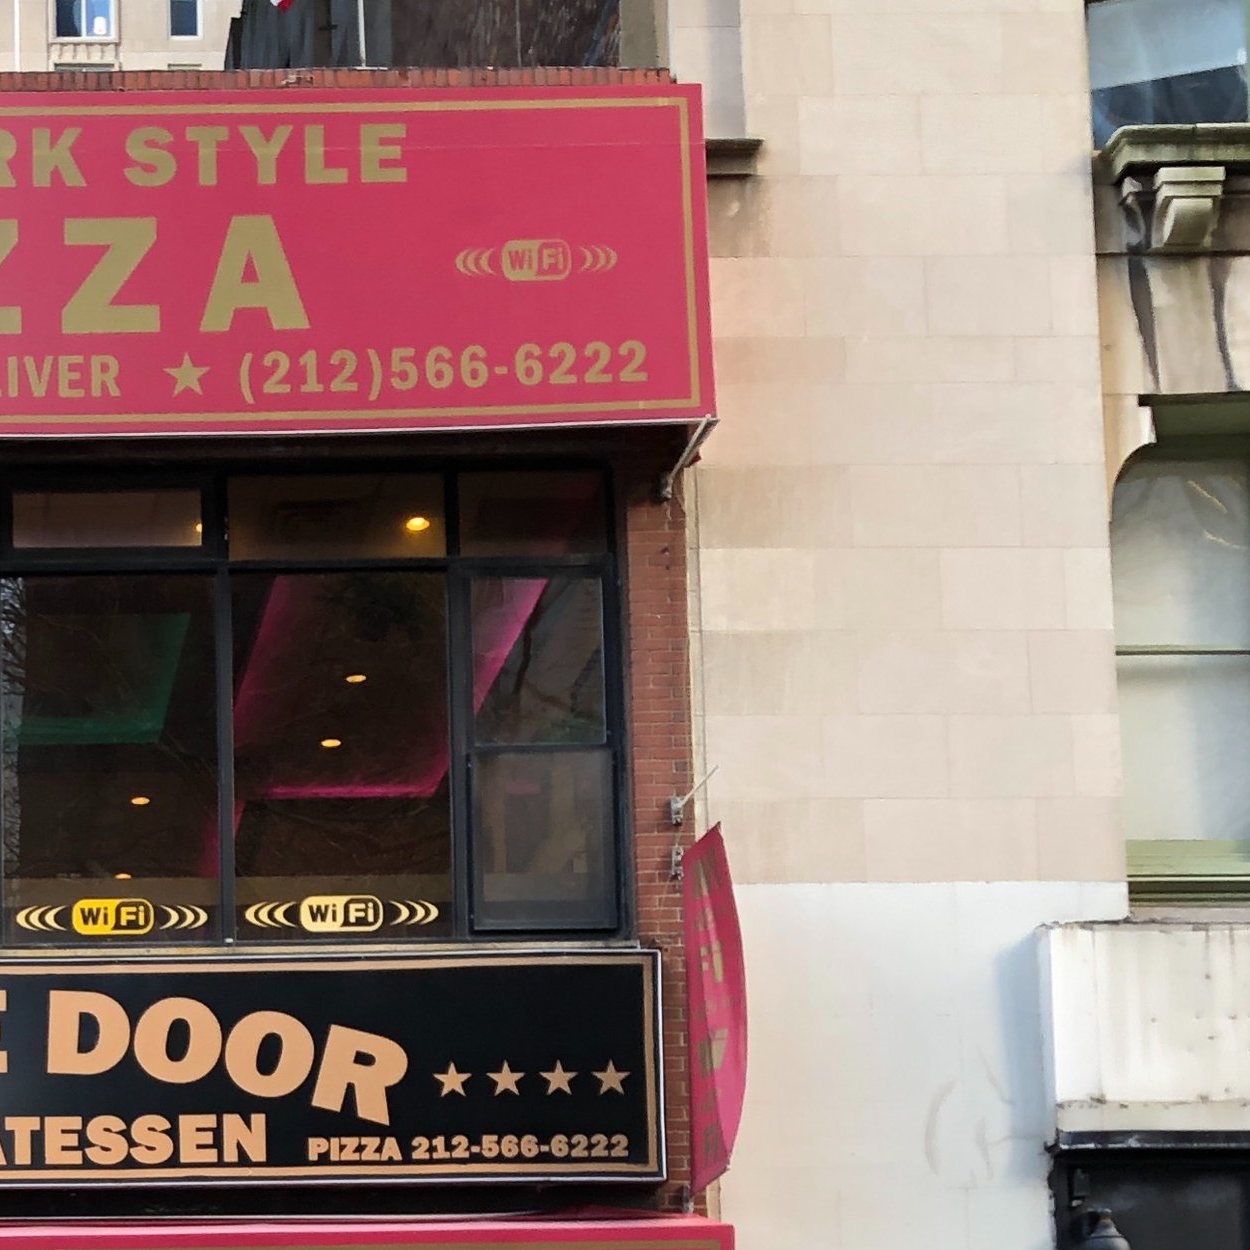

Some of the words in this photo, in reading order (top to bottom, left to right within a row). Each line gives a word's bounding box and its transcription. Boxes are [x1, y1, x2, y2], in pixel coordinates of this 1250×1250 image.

[124, 123, 409, 187] STYLE
[238, 341, 648, 405] (212)566-6222
[46, 988, 410, 1127] DOOR
[308, 1136, 404, 1162] PIZZA
[411, 1134, 630, 1161] 212-566-6222
